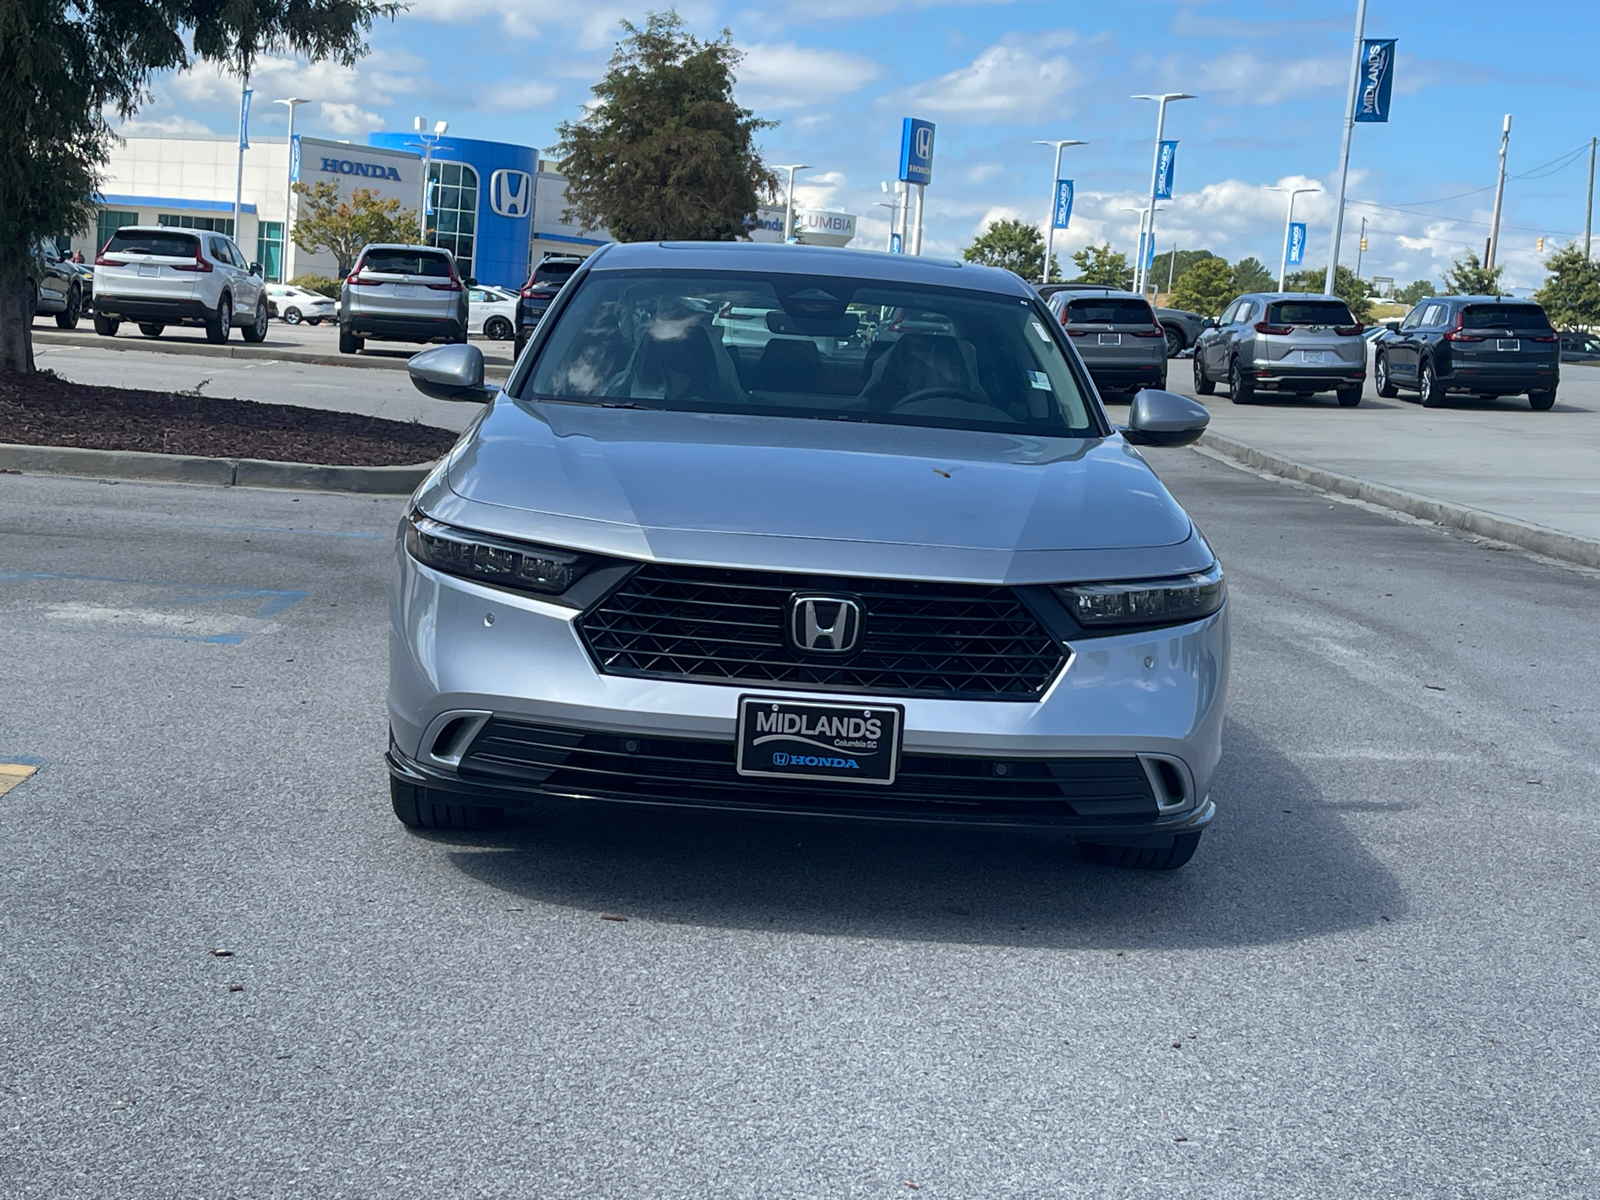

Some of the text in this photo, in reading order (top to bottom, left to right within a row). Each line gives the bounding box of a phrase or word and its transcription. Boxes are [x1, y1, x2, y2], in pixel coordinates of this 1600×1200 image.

[1363, 45, 1381, 113] MIDLANDS
[320, 156, 403, 182] HONDA
[909, 164, 931, 175] HOND
[1157, 144, 1170, 195] MIDLANDS
[799, 214, 852, 232] LUMBIA
[756, 711, 882, 740] MIDLANDS
[833, 738, 878, 749] Columbia SC
[789, 755, 860, 769] HONDA
